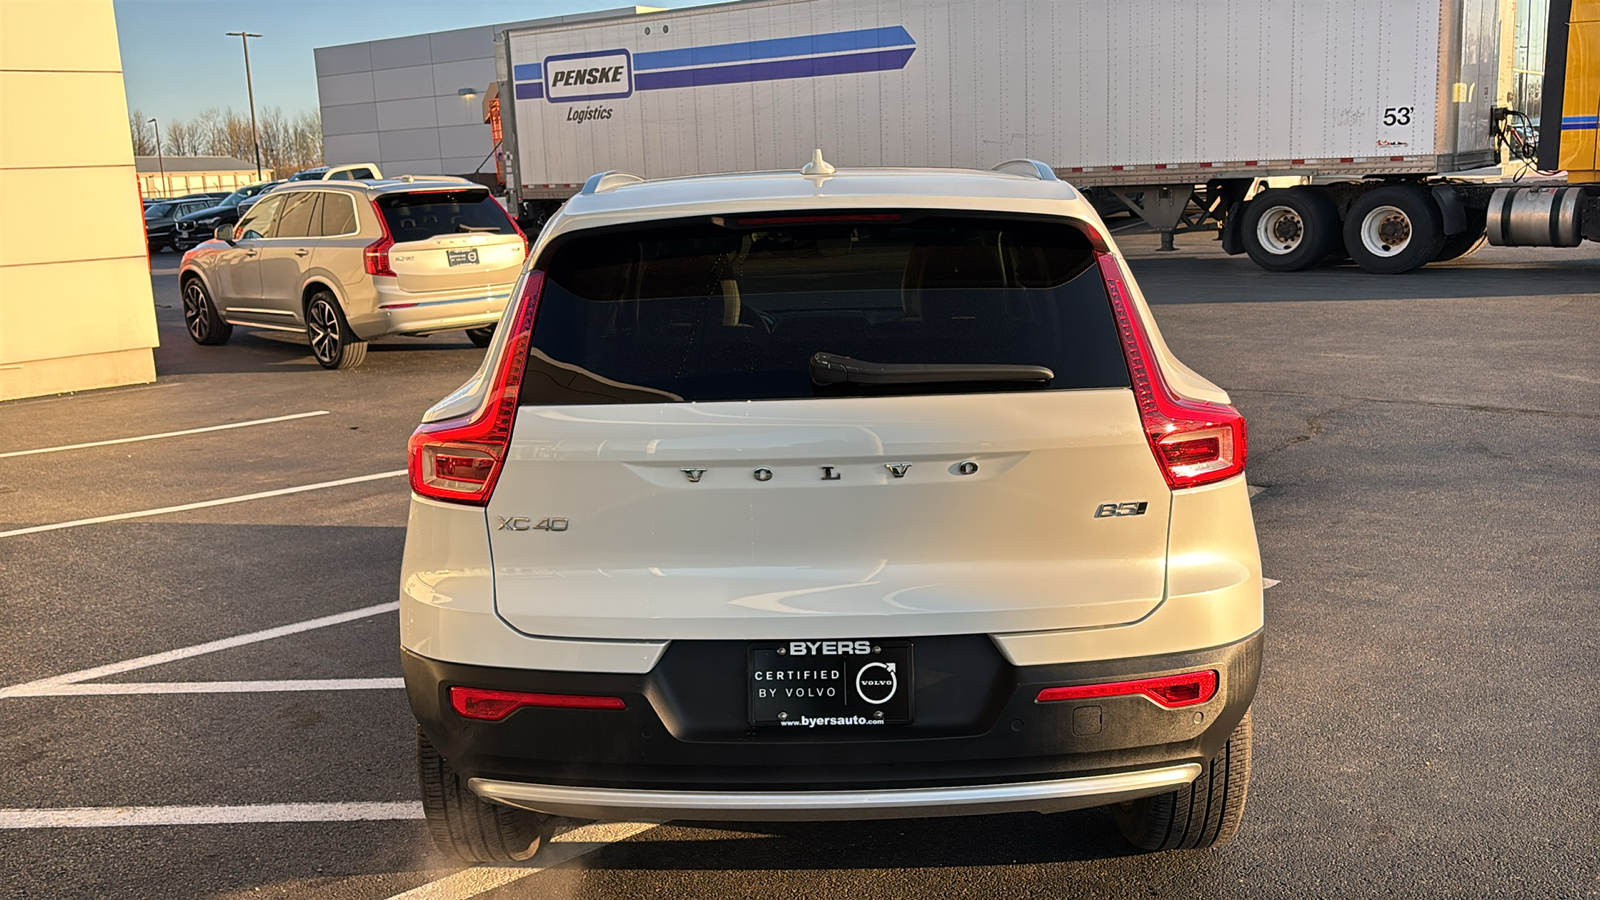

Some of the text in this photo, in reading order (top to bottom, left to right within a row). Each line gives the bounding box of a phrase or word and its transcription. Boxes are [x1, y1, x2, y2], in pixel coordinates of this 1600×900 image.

[551, 65, 624, 88] PENSKE
[566, 104, 613, 125] Logistics
[680, 459, 979, 483] VOLVO
[789, 641, 871, 656] BYERS
[754, 670, 840, 681] CERTIFIED
[758, 687, 836, 698] BY VOLVO
[780, 714, 885, 728] www.byersauto.com
